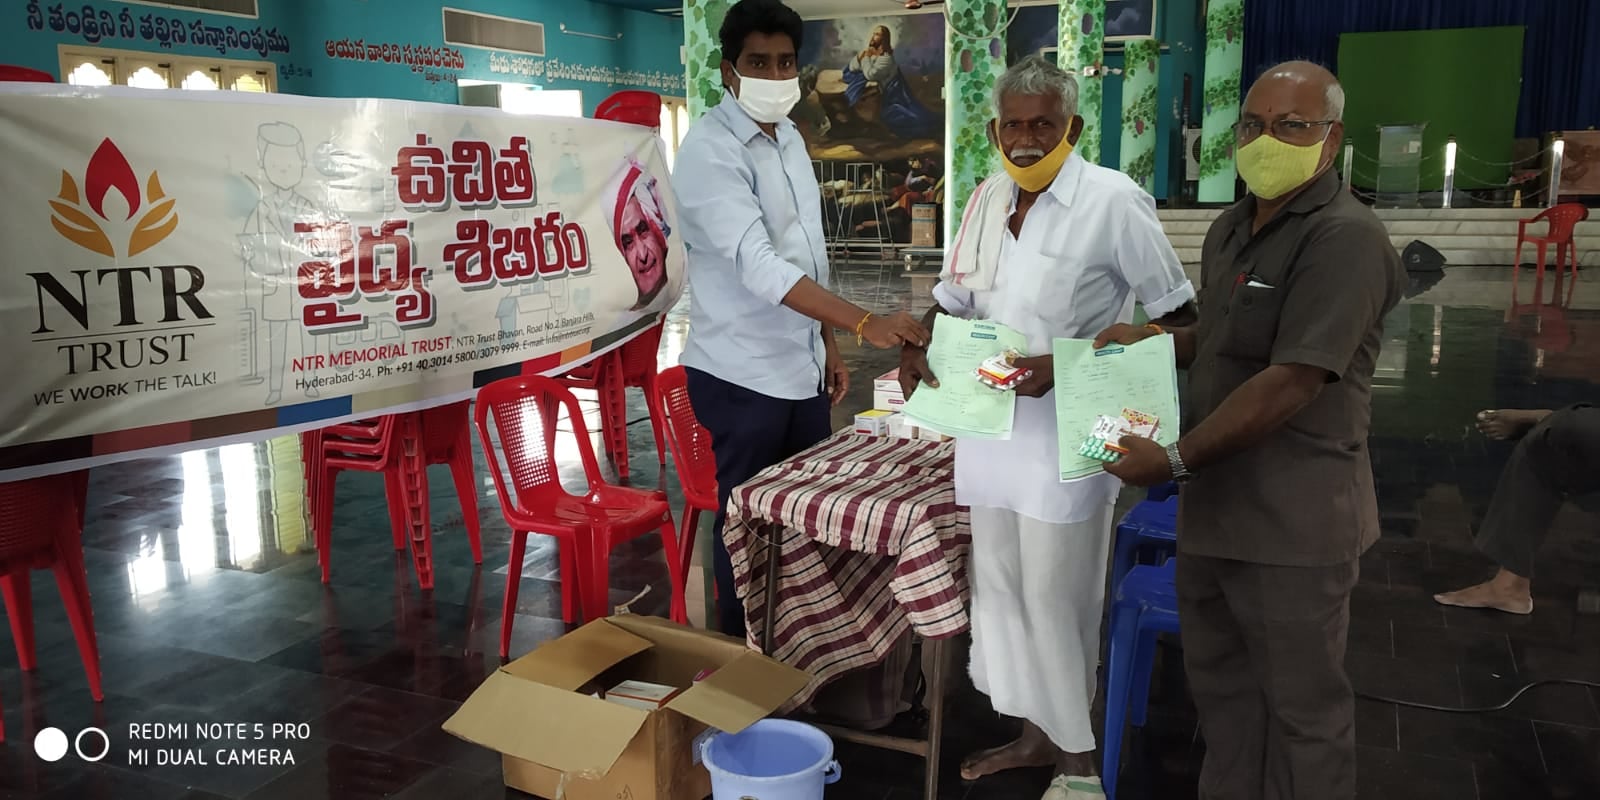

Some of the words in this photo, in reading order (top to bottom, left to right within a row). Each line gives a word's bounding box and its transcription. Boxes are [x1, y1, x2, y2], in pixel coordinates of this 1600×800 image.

[26, 0, 43, 30] నీ
[48, 3, 115, 43] తండ్రిని
[118, 7, 135, 38] నీ
[139, 13, 187, 49] తల్లిని
[188, 19, 290, 58] సన్మానింపుము
[325, 38, 366, 61] ఆయన
[367, 43, 402, 64] వారిని
[391, 133, 535, 207] ఉచిత
[293, 218, 434, 329] వైద్య
[443, 211, 591, 288] శిబిరం
[25, 264, 216, 334] NTR
[57, 332, 196, 376] TRUST
[292, 354, 325, 373] NTR
[329, 343, 409, 368] MEMORIAL
[456, 335, 475, 348] NTR
[477, 332, 496, 345] Trust
[526, 323, 543, 335] Road
[295, 368, 375, 391] Hyderabad-34.
[377, 364, 394, 378] Ph:
[396, 360, 413, 374] +91
[454, 346, 500, 365] 5800/3079
[34, 388, 65, 407] WE
[70, 381, 129, 402] WORK
[134, 376, 169, 393] THE
[174, 371, 217, 389] TALK!
